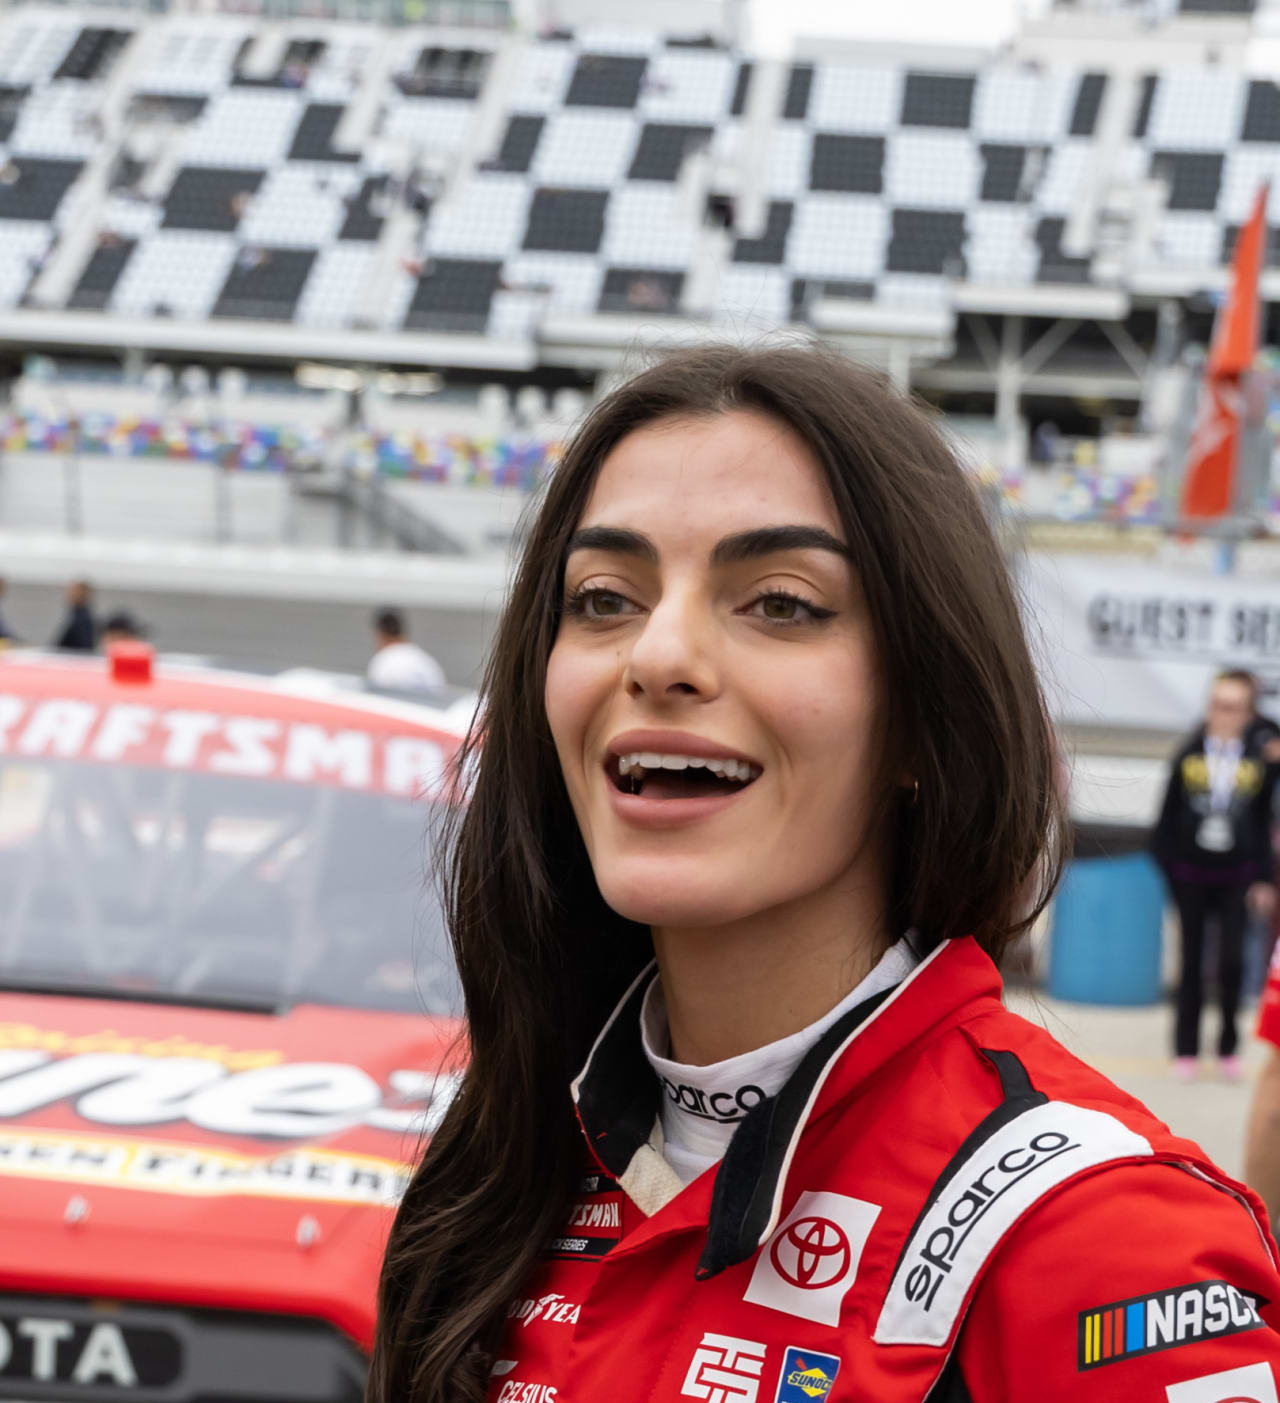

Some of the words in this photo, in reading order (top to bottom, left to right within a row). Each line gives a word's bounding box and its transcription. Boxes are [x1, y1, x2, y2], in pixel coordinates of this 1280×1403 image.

[1086, 596, 1214, 650] GUEST
[661, 1076, 766, 1117] parco
[568, 1202, 620, 1228] TSMAN
[904, 1130, 1074, 1312] sparco
[1146, 1284, 1262, 1348] NASC
